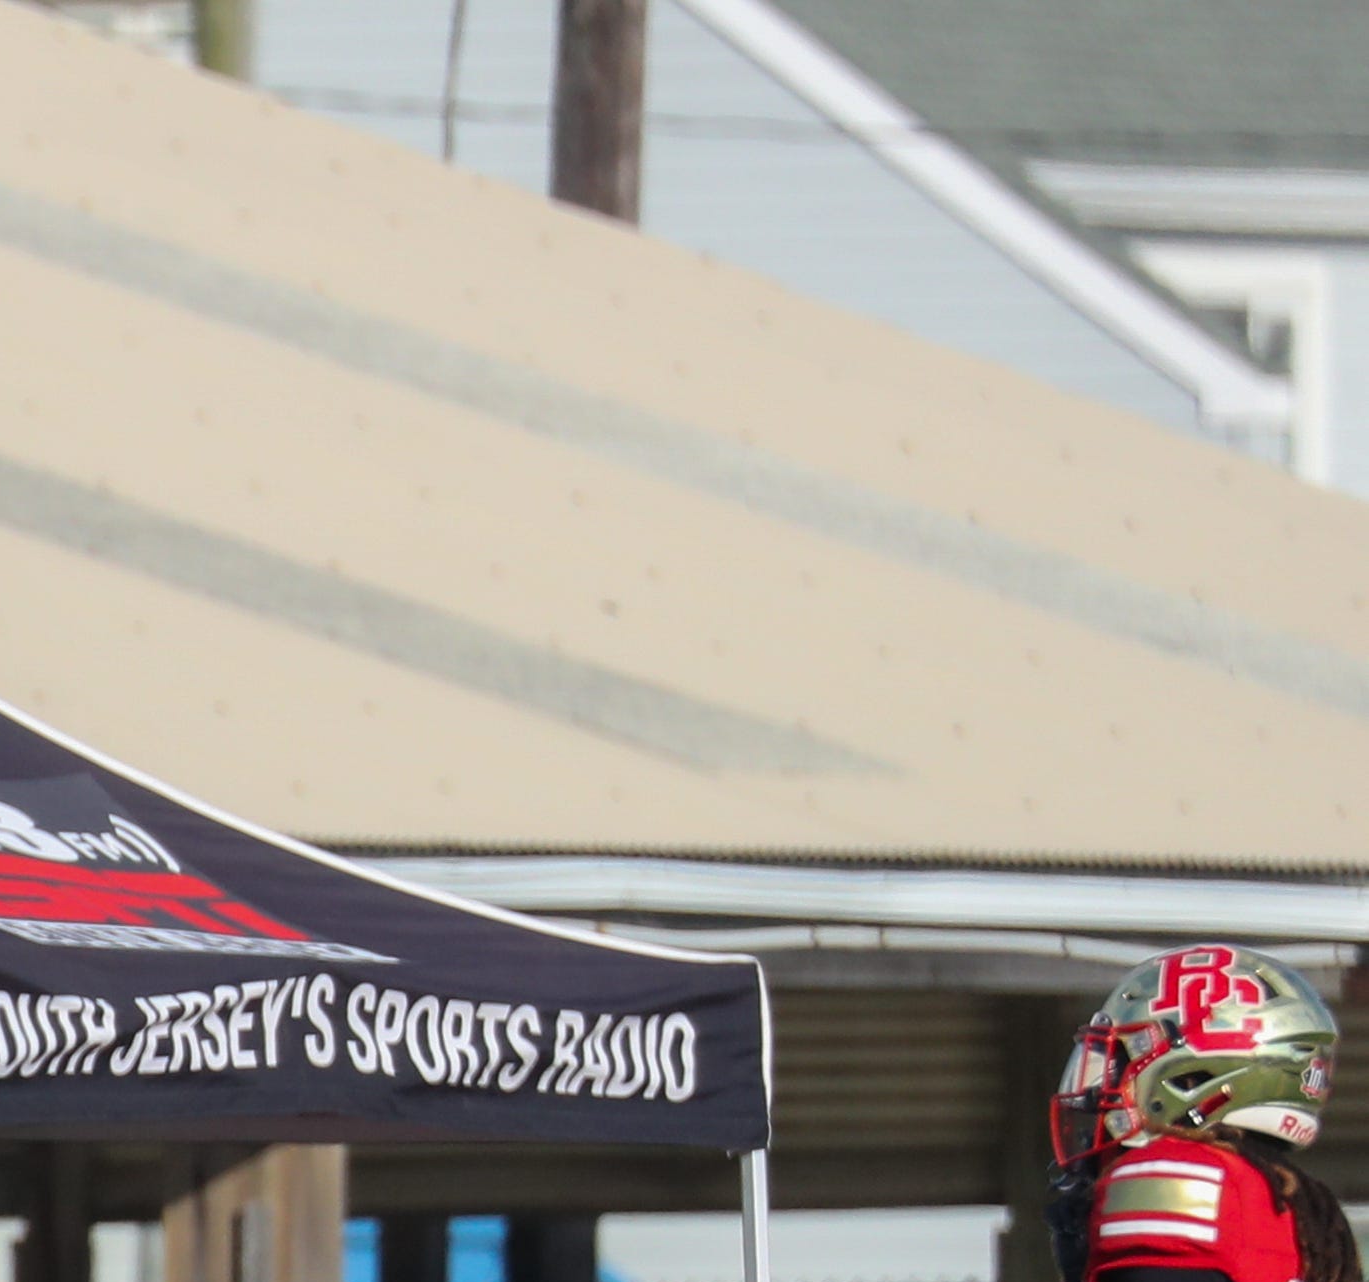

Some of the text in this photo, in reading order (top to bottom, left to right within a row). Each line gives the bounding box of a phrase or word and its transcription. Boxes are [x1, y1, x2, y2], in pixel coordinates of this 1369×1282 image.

[110, 972, 335, 1077] JERSEY'S
[346, 982, 541, 1094] SPORTS
[536, 1009, 697, 1103] RADIO
